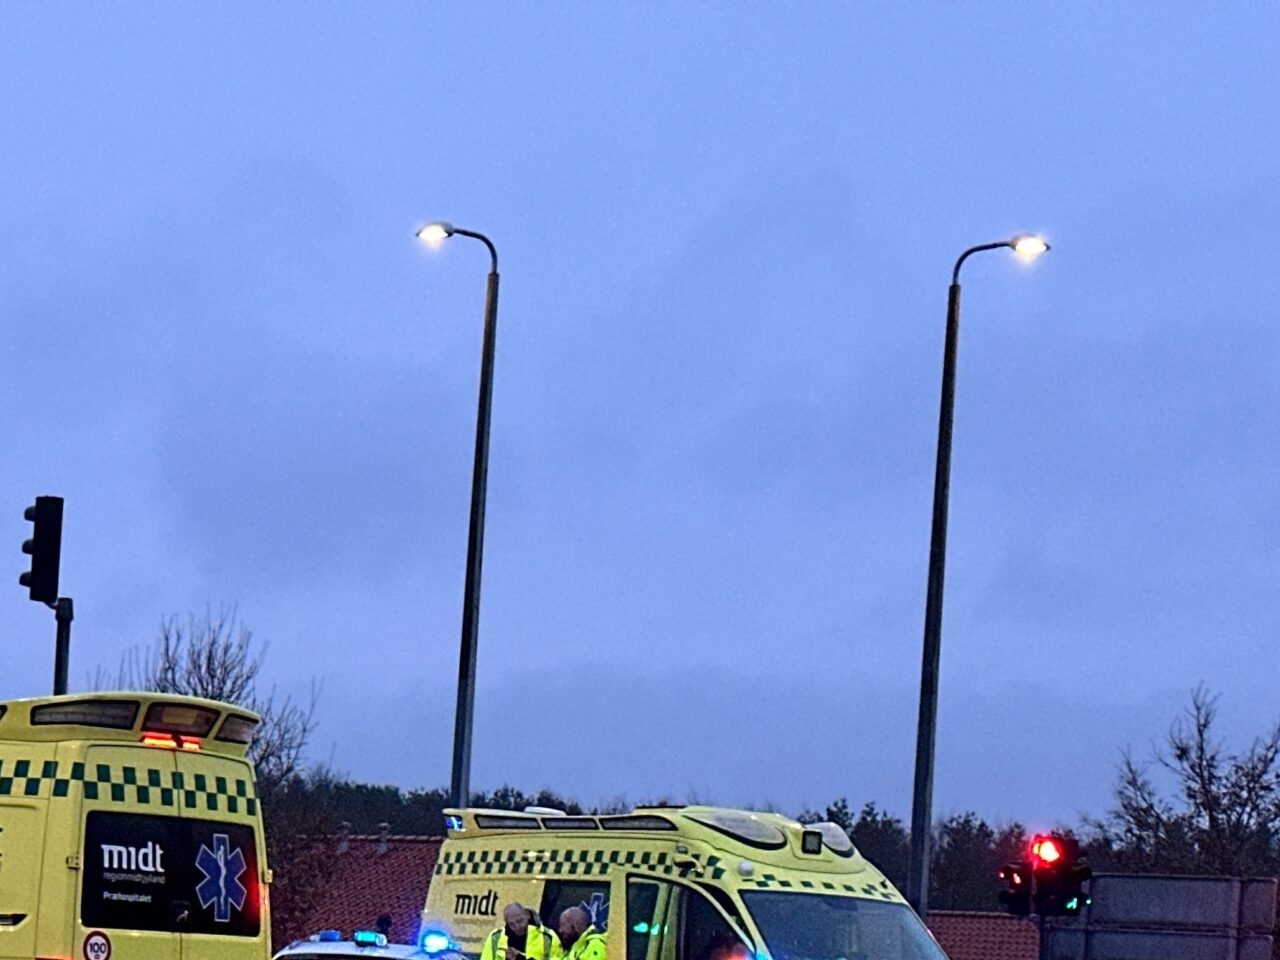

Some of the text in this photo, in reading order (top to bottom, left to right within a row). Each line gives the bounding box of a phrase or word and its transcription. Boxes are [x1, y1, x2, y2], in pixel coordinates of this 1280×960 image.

[101, 841, 166, 873] midt
[454, 889, 500, 916] midt
[89, 942, 107, 954] 100
